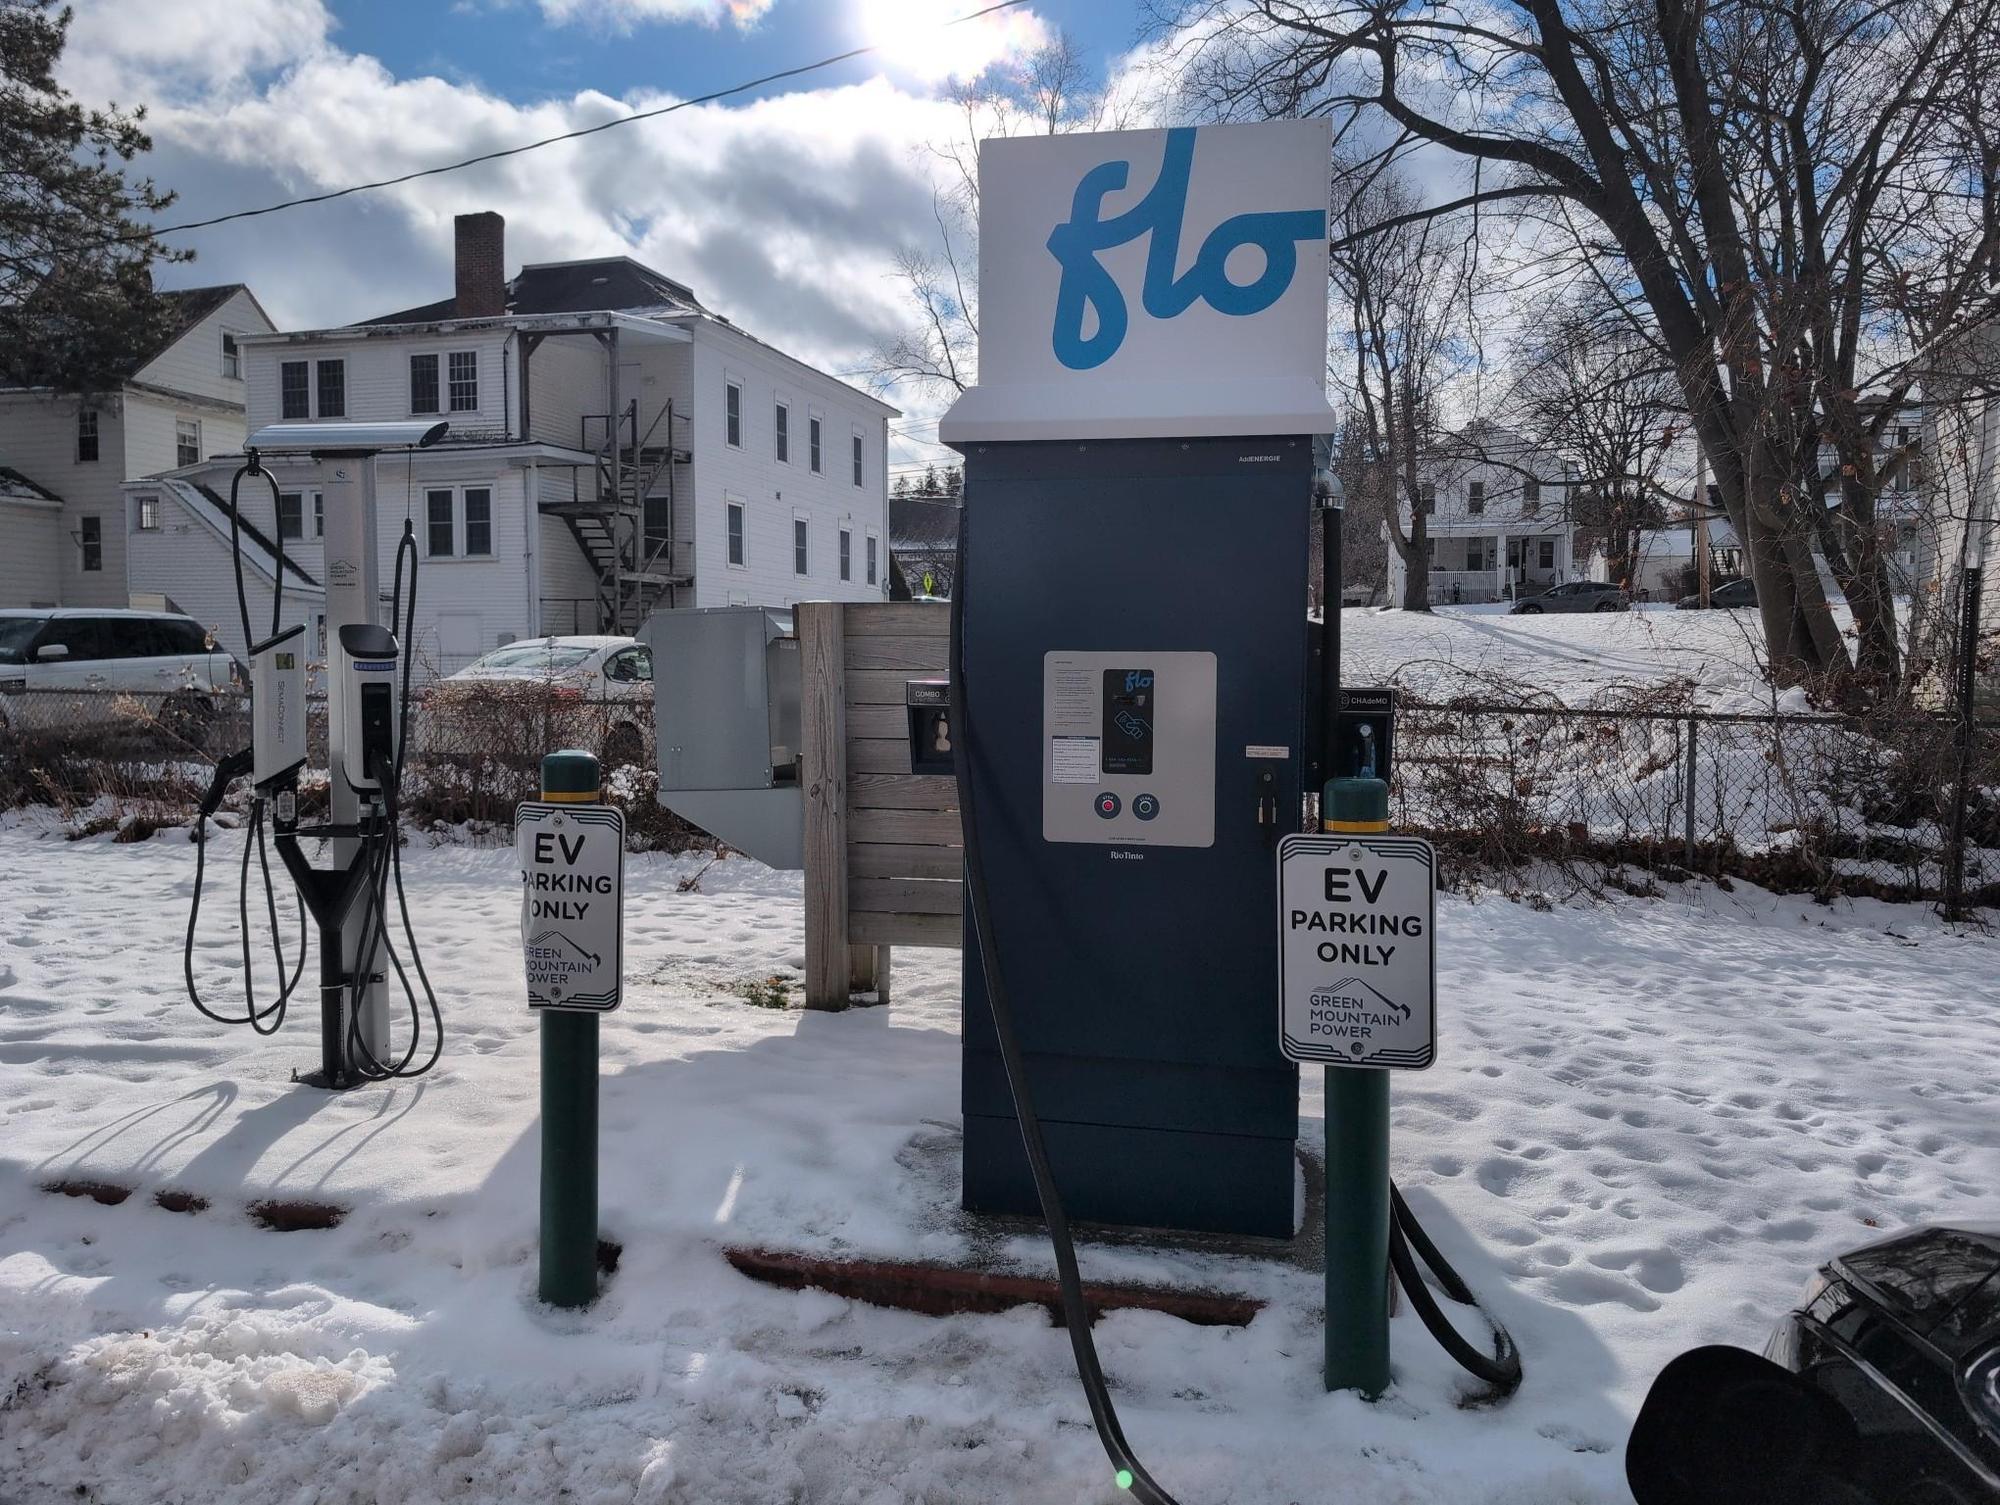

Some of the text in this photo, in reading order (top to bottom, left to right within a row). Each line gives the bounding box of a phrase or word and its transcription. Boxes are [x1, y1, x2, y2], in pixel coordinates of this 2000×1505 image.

[1046, 127, 1326, 370] flo
[1125, 671, 1154, 693] flo
[915, 690, 940, 698] COMBO
[1351, 697, 1388, 705] CHAdeMO
[534, 832, 586, 866] EV
[1324, 867, 1388, 904] EV
[531, 900, 590, 920] ONLY
[1291, 910, 1423, 937] PARKING
[1317, 942, 1396, 966] ONLY
[525, 961, 592, 973] OUNTAIN
[527, 973, 569, 985] OWER
[1310, 995, 1364, 1009] GREEN
[1310, 1009, 1401, 1026] MOUNTAIN
[1310, 1024, 1372, 1039] POWER
